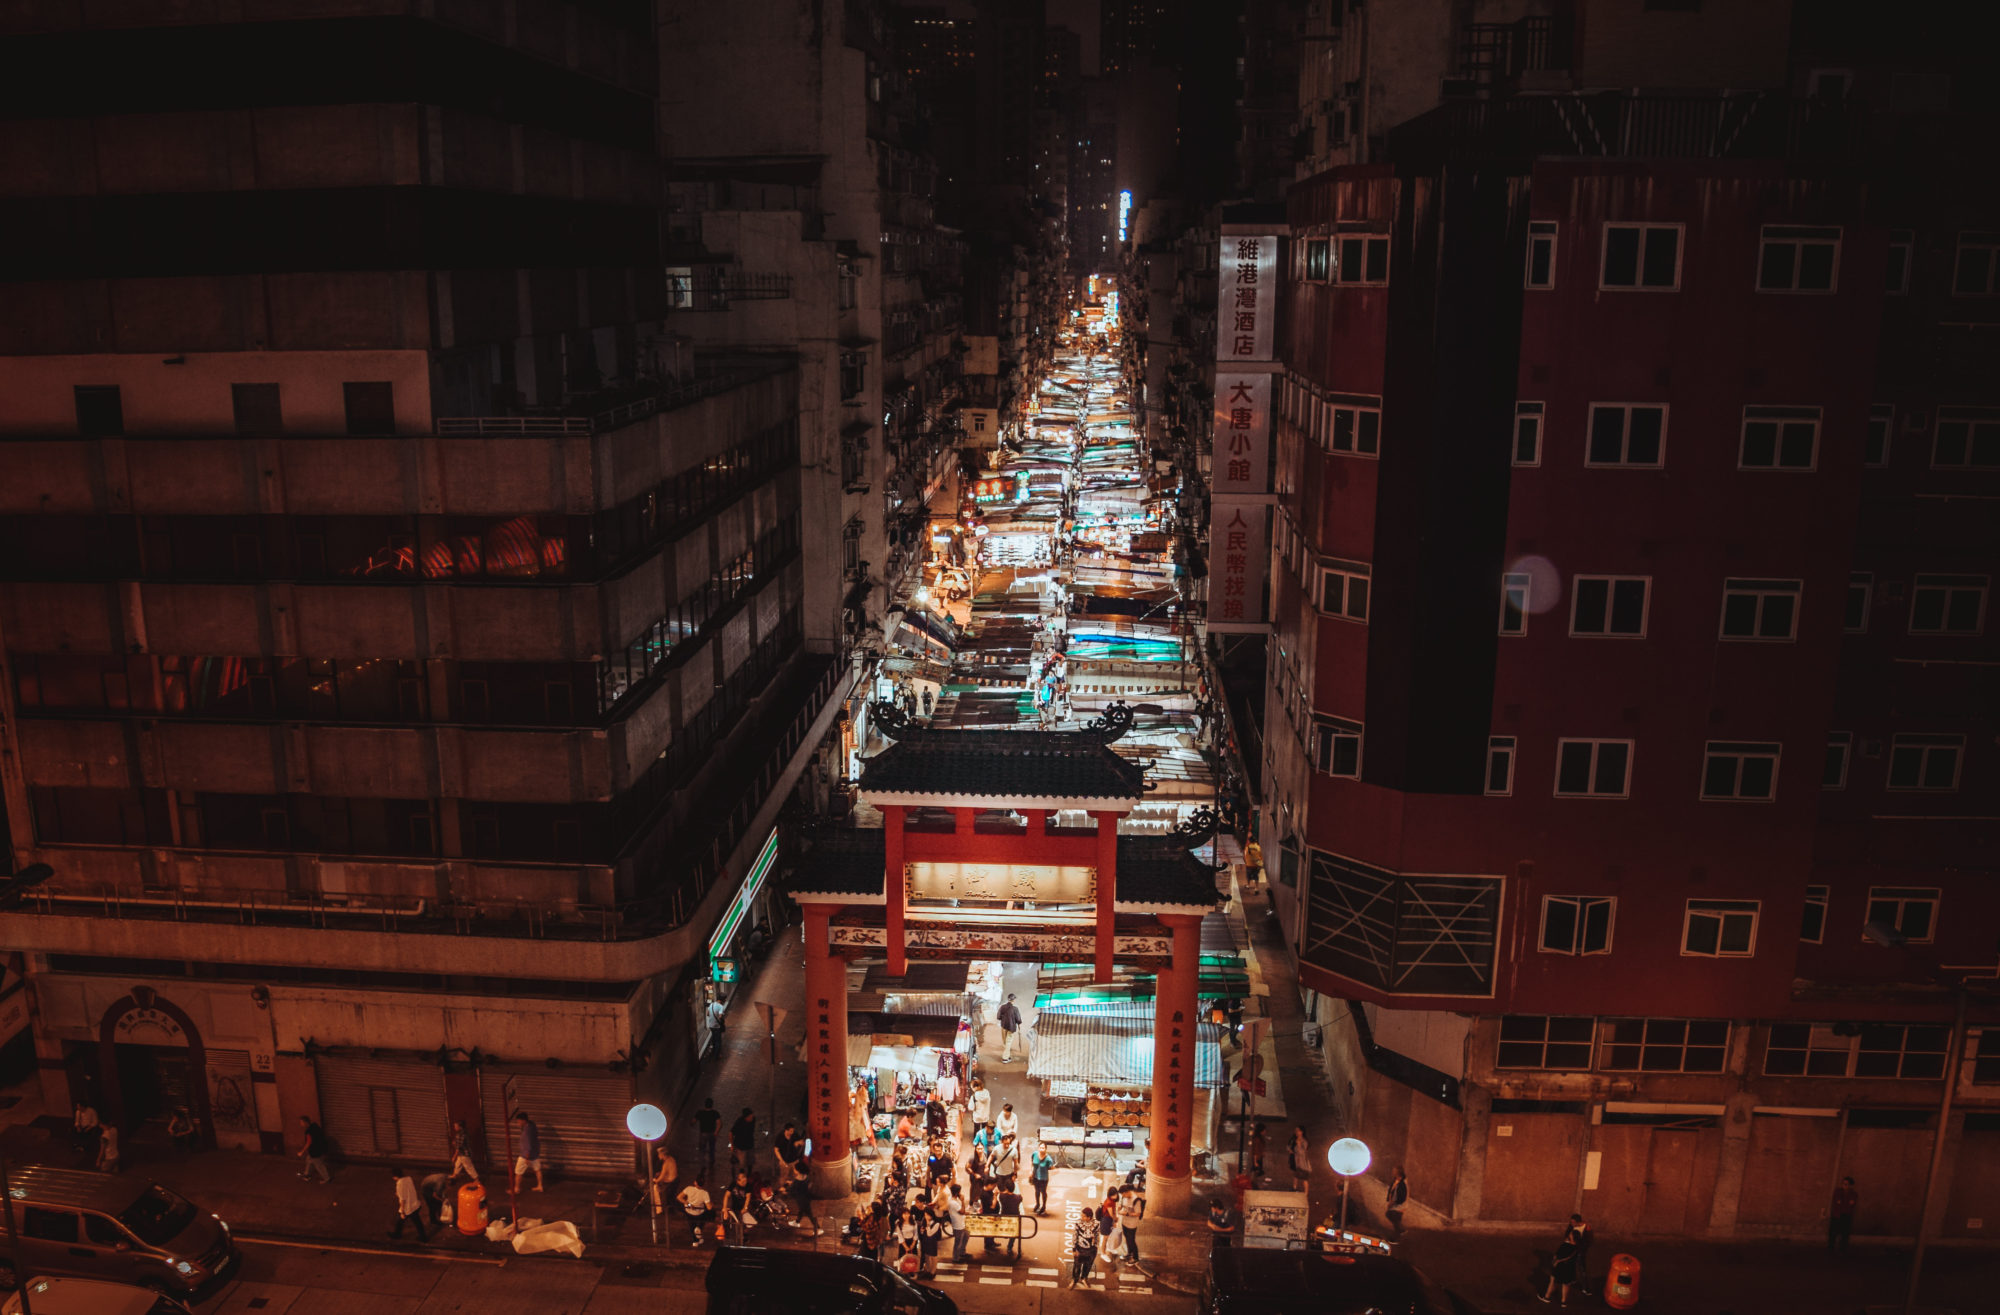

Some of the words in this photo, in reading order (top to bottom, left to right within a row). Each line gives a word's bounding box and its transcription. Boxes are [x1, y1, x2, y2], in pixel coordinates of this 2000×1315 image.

[1232, 238, 1259, 357] 維港灣酒店
[1228, 380, 1254, 482] 大唐小館
[1223, 508, 1248, 620] 人民幣找換
[256, 1054, 271, 1065] 22
[1065, 1200, 1081, 1230] RIGHT
